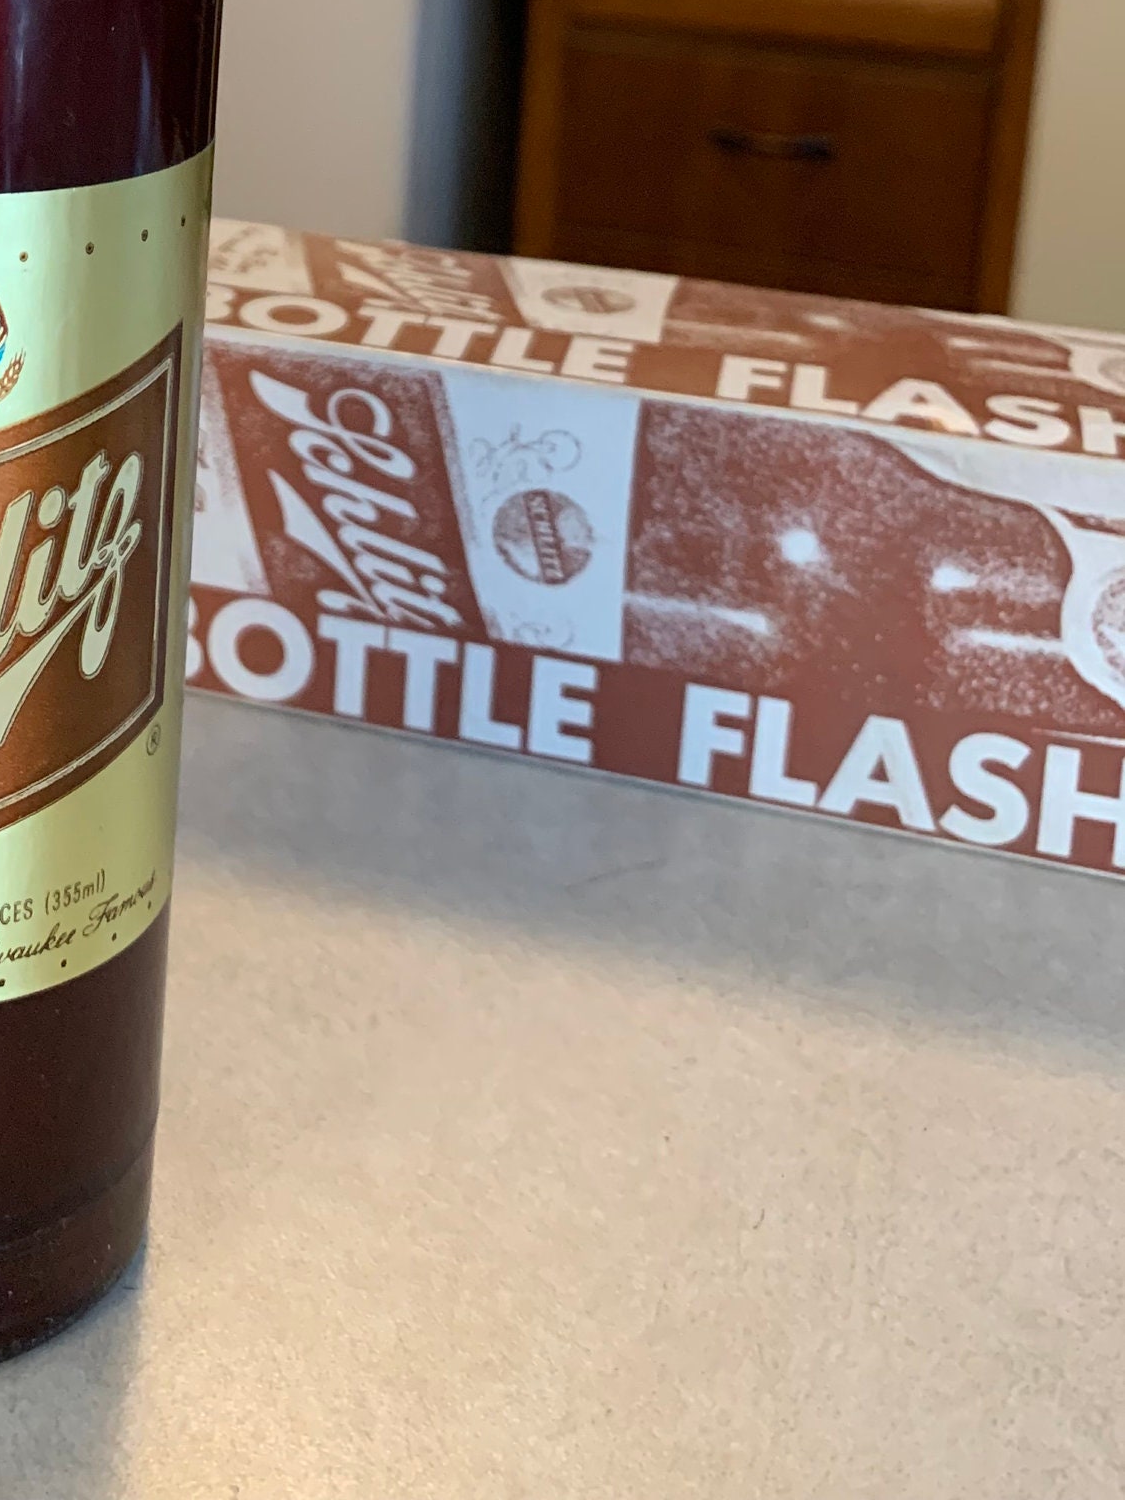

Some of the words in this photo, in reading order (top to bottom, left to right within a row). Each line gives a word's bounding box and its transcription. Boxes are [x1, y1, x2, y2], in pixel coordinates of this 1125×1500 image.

[186, 595, 599, 765] OTTLE
[678, 682, 1125, 870] FLASH
[45, 868, 106, 916] (355ml)
